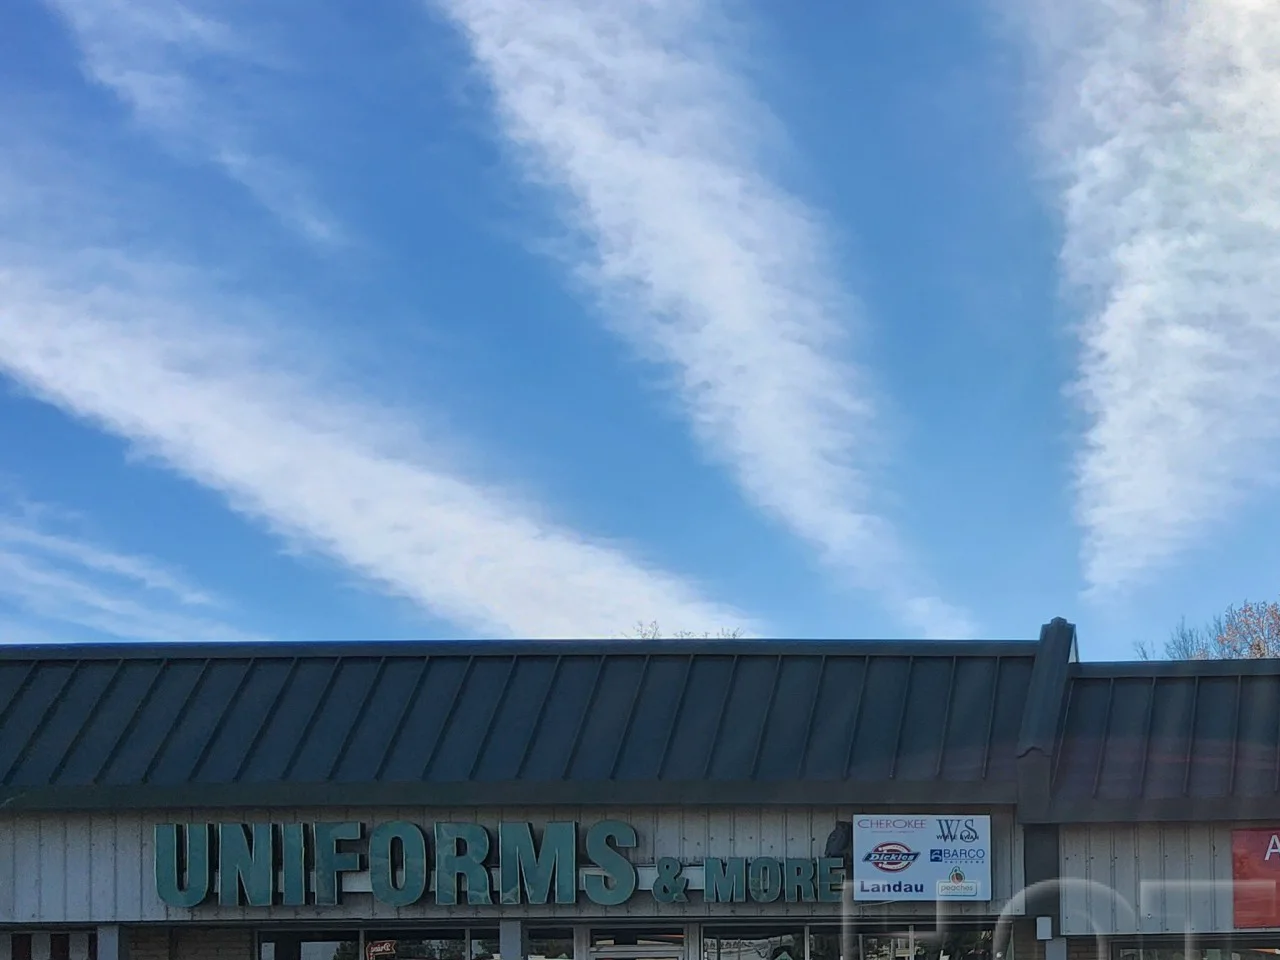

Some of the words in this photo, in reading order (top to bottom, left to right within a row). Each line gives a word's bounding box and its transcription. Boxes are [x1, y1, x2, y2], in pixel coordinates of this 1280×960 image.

[858, 819, 927, 829] CHEROKEE
[869, 853, 915, 862] Dickies
[943, 848, 986, 859] BARCO
[153, 820, 639, 906] UNIFORMS
[652, 857, 688, 903] &
[704, 856, 846, 903] MORE
[860, 881, 924, 893] Landau
[941, 884, 974, 892] peaches
